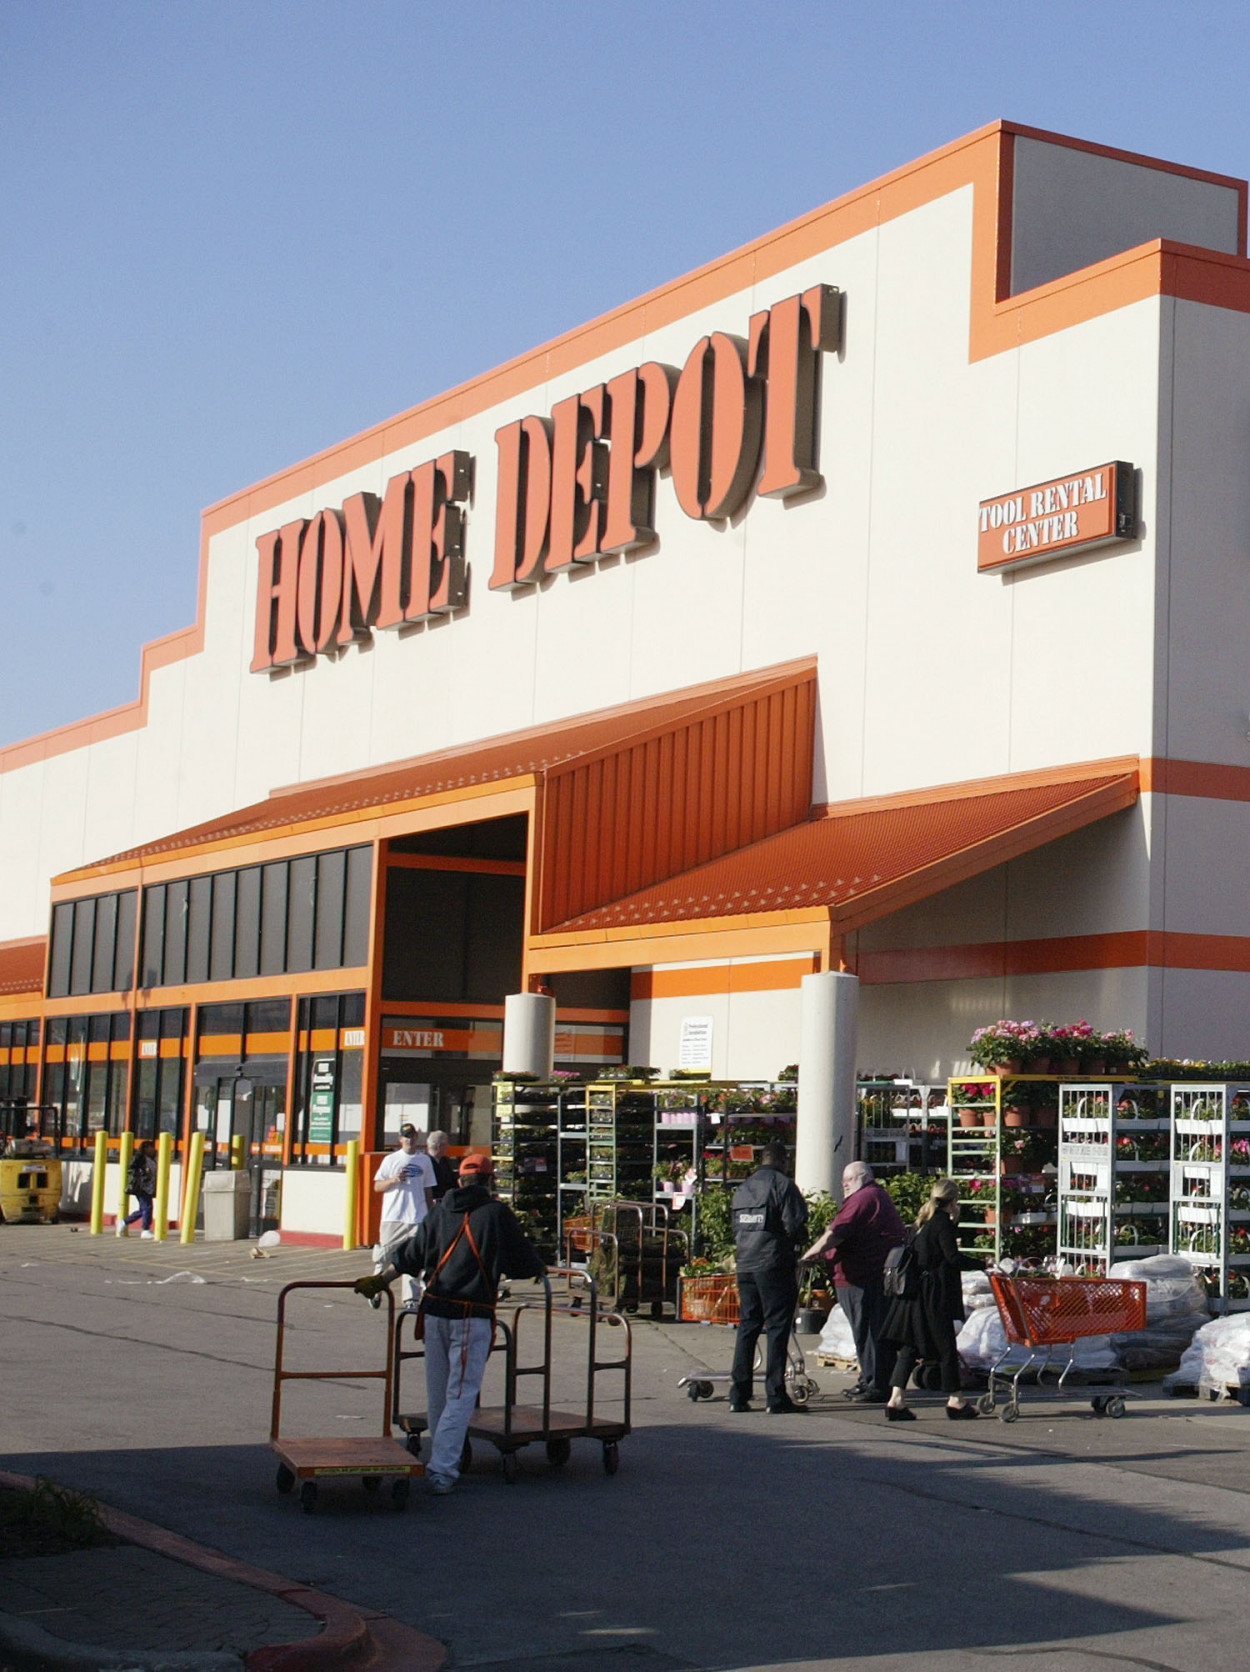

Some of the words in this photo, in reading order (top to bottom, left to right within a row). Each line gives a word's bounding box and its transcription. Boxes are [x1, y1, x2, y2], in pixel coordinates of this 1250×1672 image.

[250, 450, 469, 674] HOME
[488, 283, 840, 592] DEPOT
[979, 496, 1027, 533] TOOL
[1031, 473, 1107, 518] RENTAL
[1003, 511, 1079, 554] CENTER
[393, 1030, 445, 1047] ENTER
